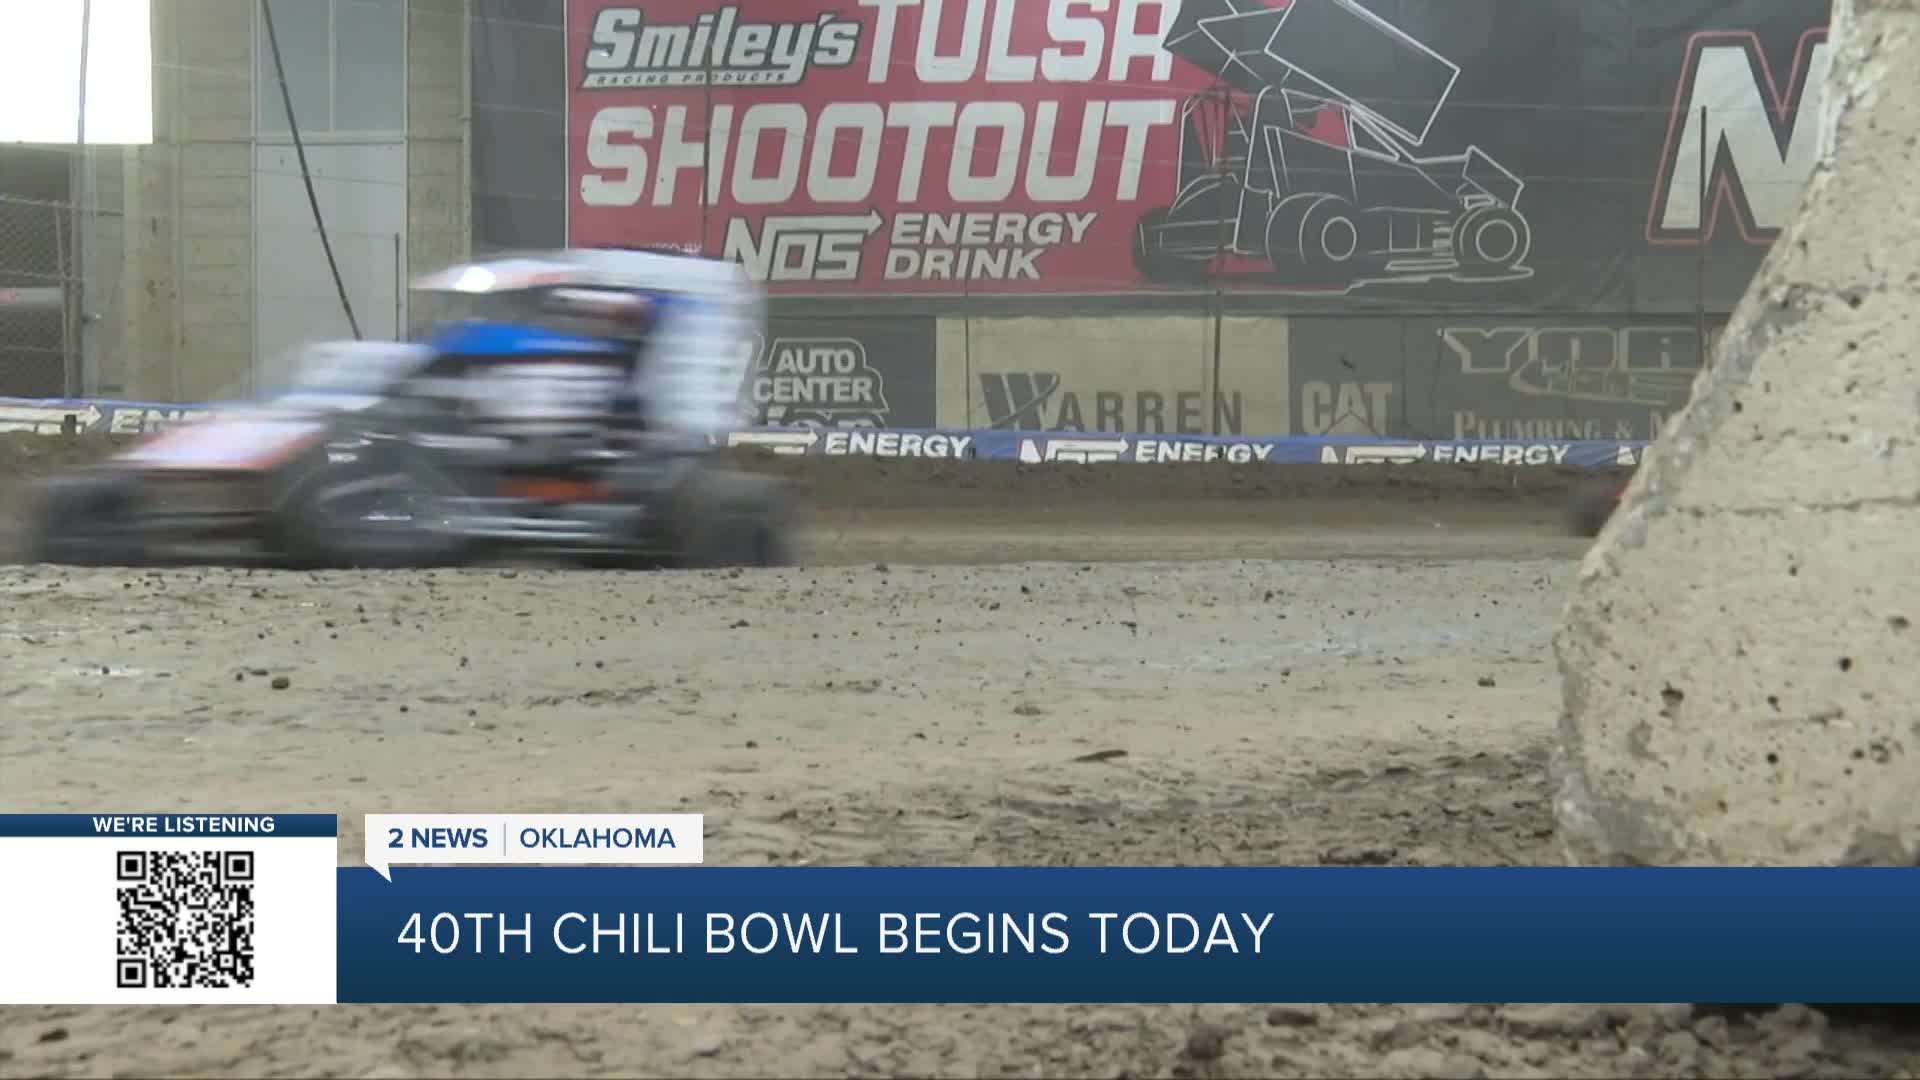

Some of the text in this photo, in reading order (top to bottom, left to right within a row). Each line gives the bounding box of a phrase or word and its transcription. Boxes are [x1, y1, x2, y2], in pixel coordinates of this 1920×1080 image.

[586, 6, 860, 84] Smiley's
[858, 0, 1181, 84] TULSA
[581, 100, 1176, 207] SHOOTOUT
[891, 212, 1096, 245] ENERGY
[723, 217, 865, 281] NOS
[884, 249, 1043, 280] DRINK
[776, 348, 856, 374] AUTO
[753, 376, 874, 402] CENTER
[979, 374, 1243, 433] WARREN
[1302, 382, 1393, 435] CAT
[825, 431, 972, 458] ENERGY
[1135, 440, 1274, 463] ENERGY
[1432, 444, 1571, 465] ENERGY
